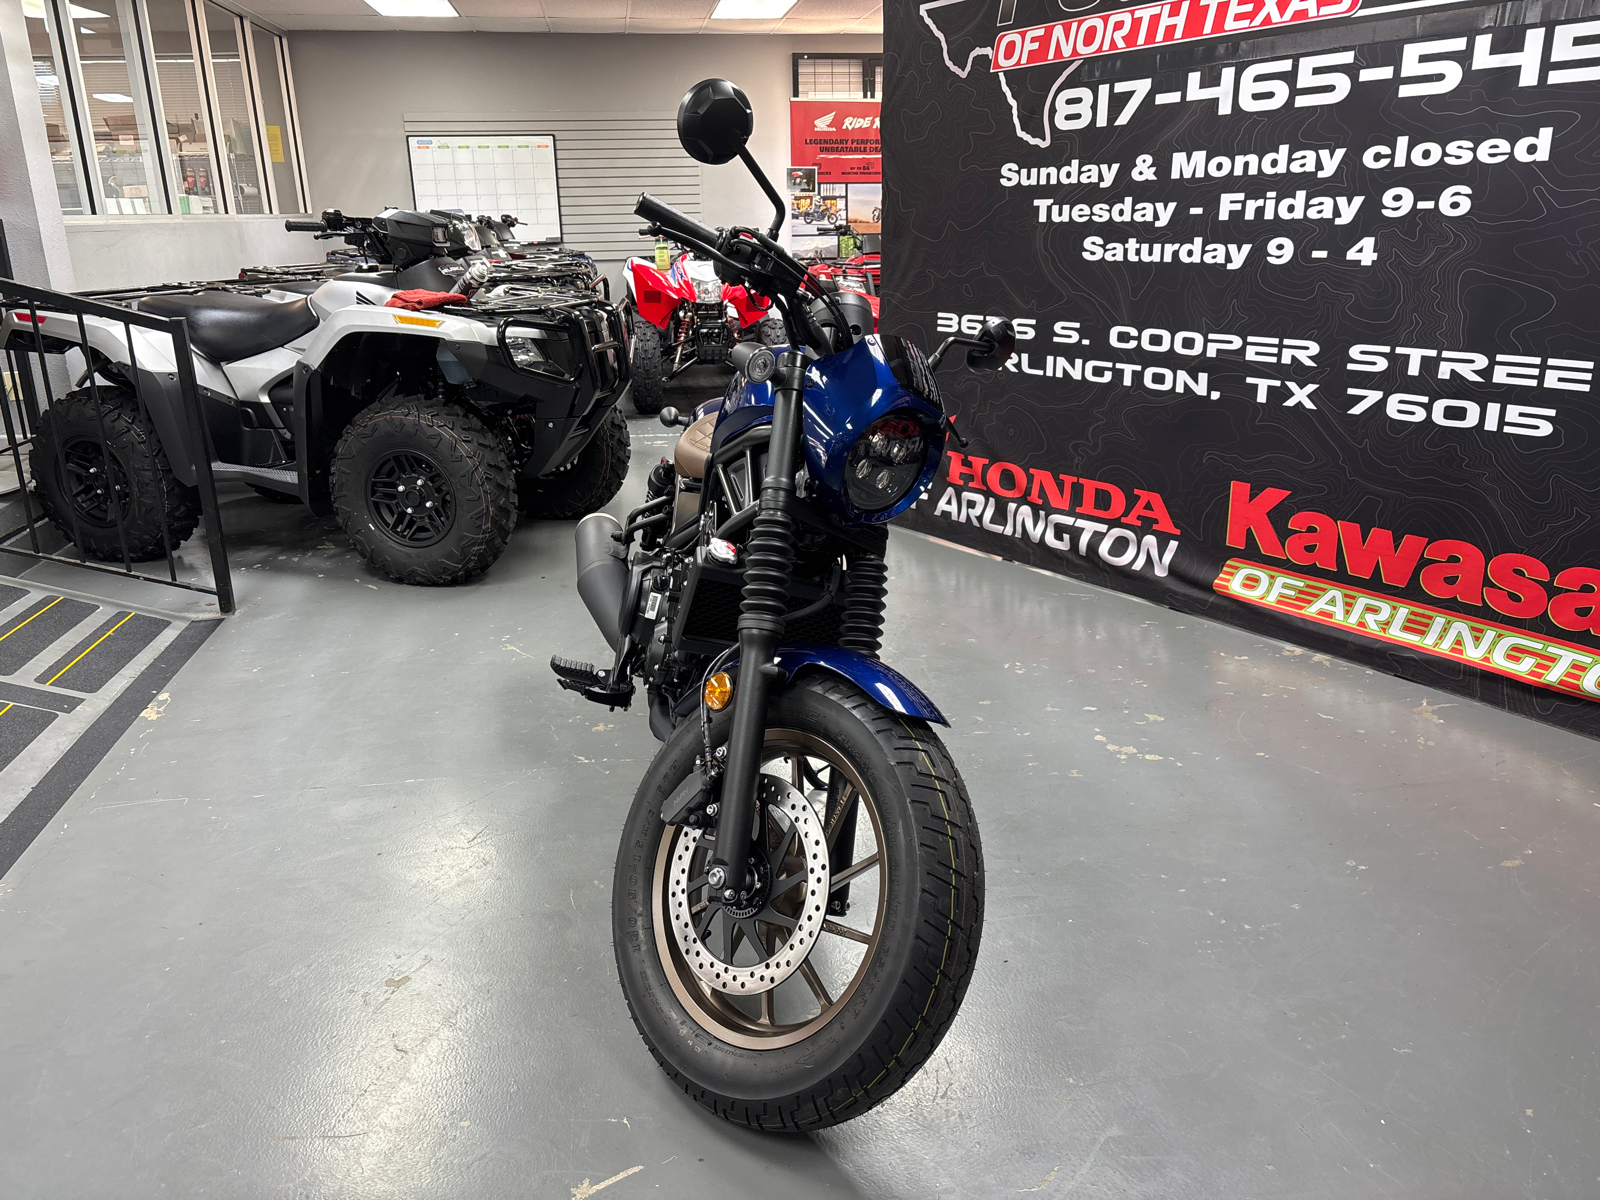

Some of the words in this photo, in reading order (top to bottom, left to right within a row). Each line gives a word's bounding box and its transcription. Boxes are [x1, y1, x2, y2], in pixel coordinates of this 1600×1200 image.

[998, 28, 1045, 67] OF
[1047, 7, 1187, 60] NORTH
[1053, 21, 1600, 131] 817-465-545
[842, 116, 873, 130] RIDE
[1000, 159, 1120, 188] Sunday
[1131, 154, 1158, 182] &
[1171, 144, 1347, 180] Monday
[1362, 127, 1553, 169] closed
[1033, 197, 1177, 227] Tuesday
[1189, 207, 1203, 215] -
[1218, 190, 1365, 226] Friday
[1381, 185, 1473, 218] 9-6
[1082, 236, 1252, 269] Saturday
[1266, 236, 1295, 265] 9
[1311, 250, 1328, 258] -
[1346, 236, 1378, 266] 4
[937, 312, 1037, 340] 366
[1053, 321, 1090, 346] S.
[1109, 325, 1321, 367] COOPER
[1346, 344, 1595, 393] STREE
[998, 352, 1221, 401] RLINGTON,
[1245, 377, 1321, 410] TX
[1346, 387, 1557, 437] 76015
[946, 450, 1181, 535] HONDA
[934, 486, 1179, 578] ARLINGTON
[1226, 480, 1600, 637] Kawasa
[1229, 567, 1305, 603] OF
